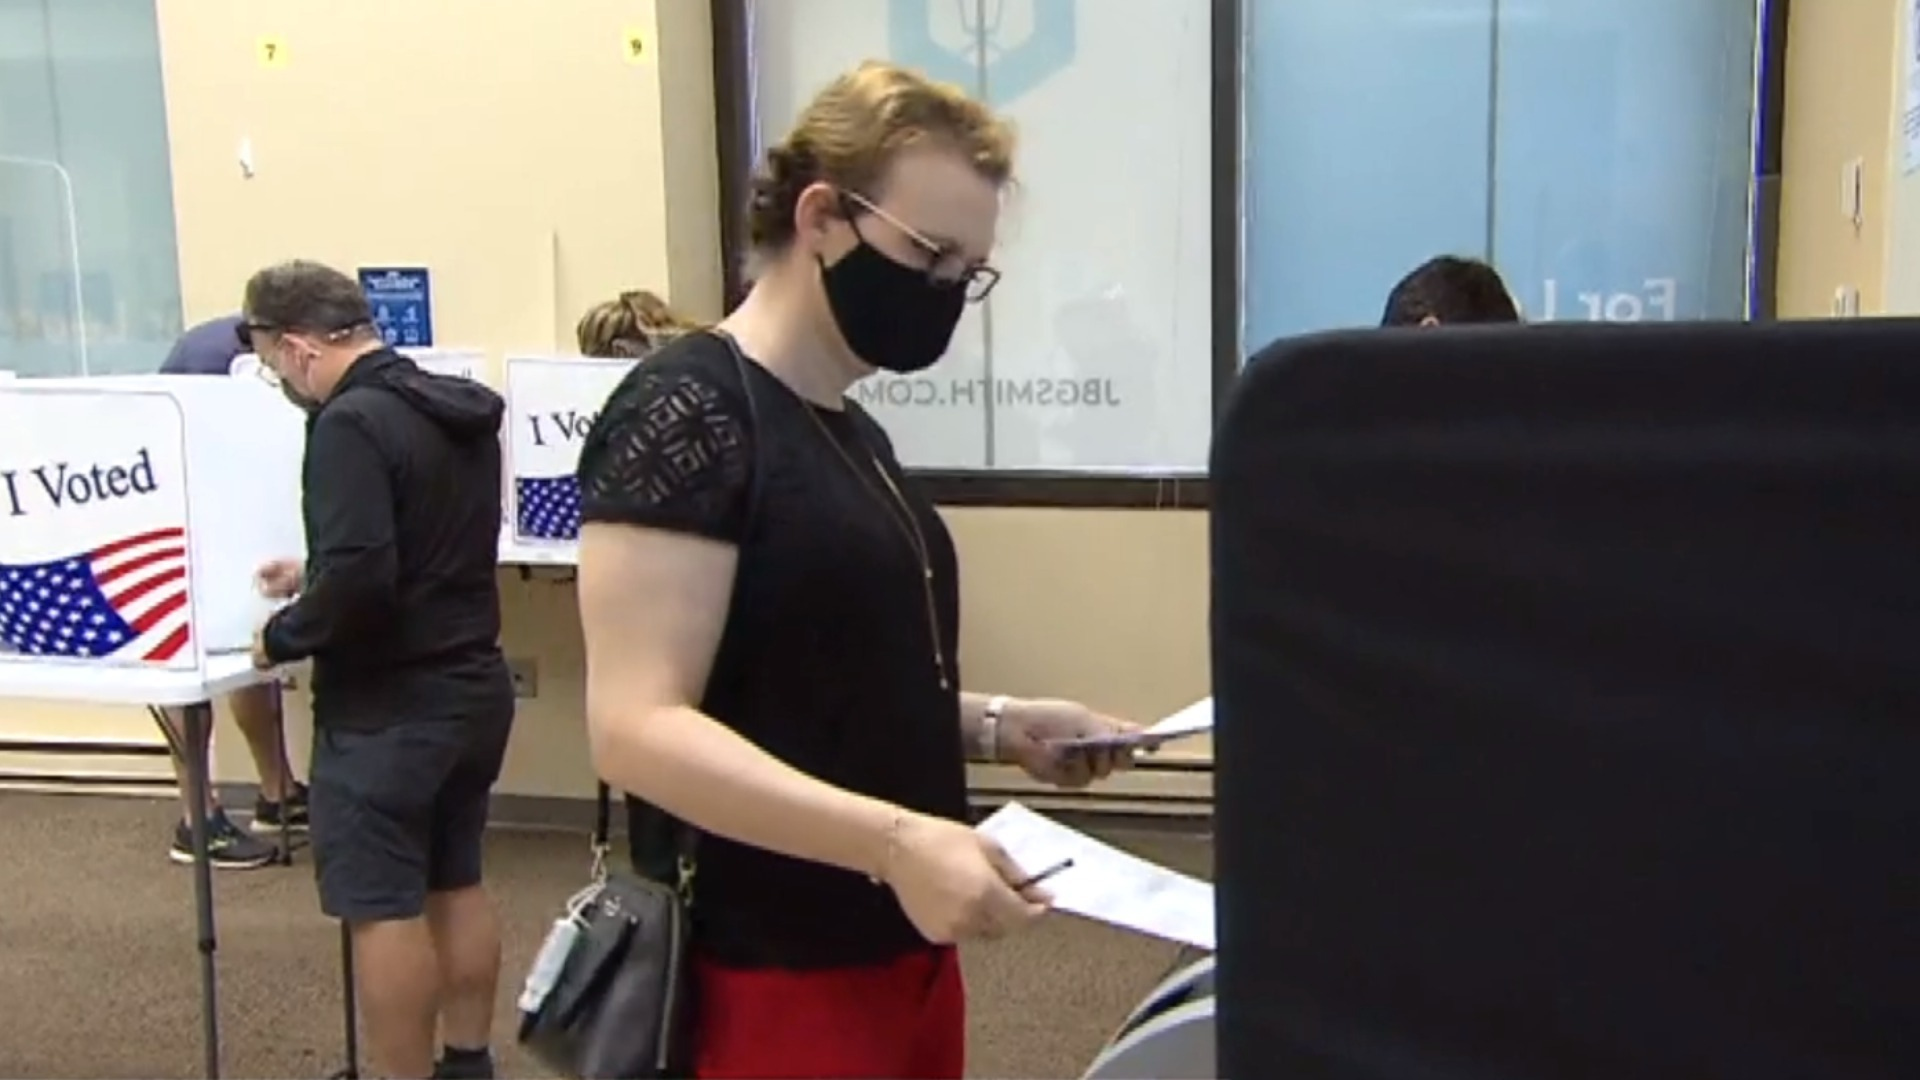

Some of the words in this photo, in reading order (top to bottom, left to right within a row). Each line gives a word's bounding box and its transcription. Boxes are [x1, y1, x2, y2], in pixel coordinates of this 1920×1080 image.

[264, 43, 276, 61] 7
[630, 38, 642, 57] 9
[527, 415, 546, 446] I
[550, 410, 602, 441] Vo
[1, 469, 27, 516] I
[30, 446, 159, 508] Voted
